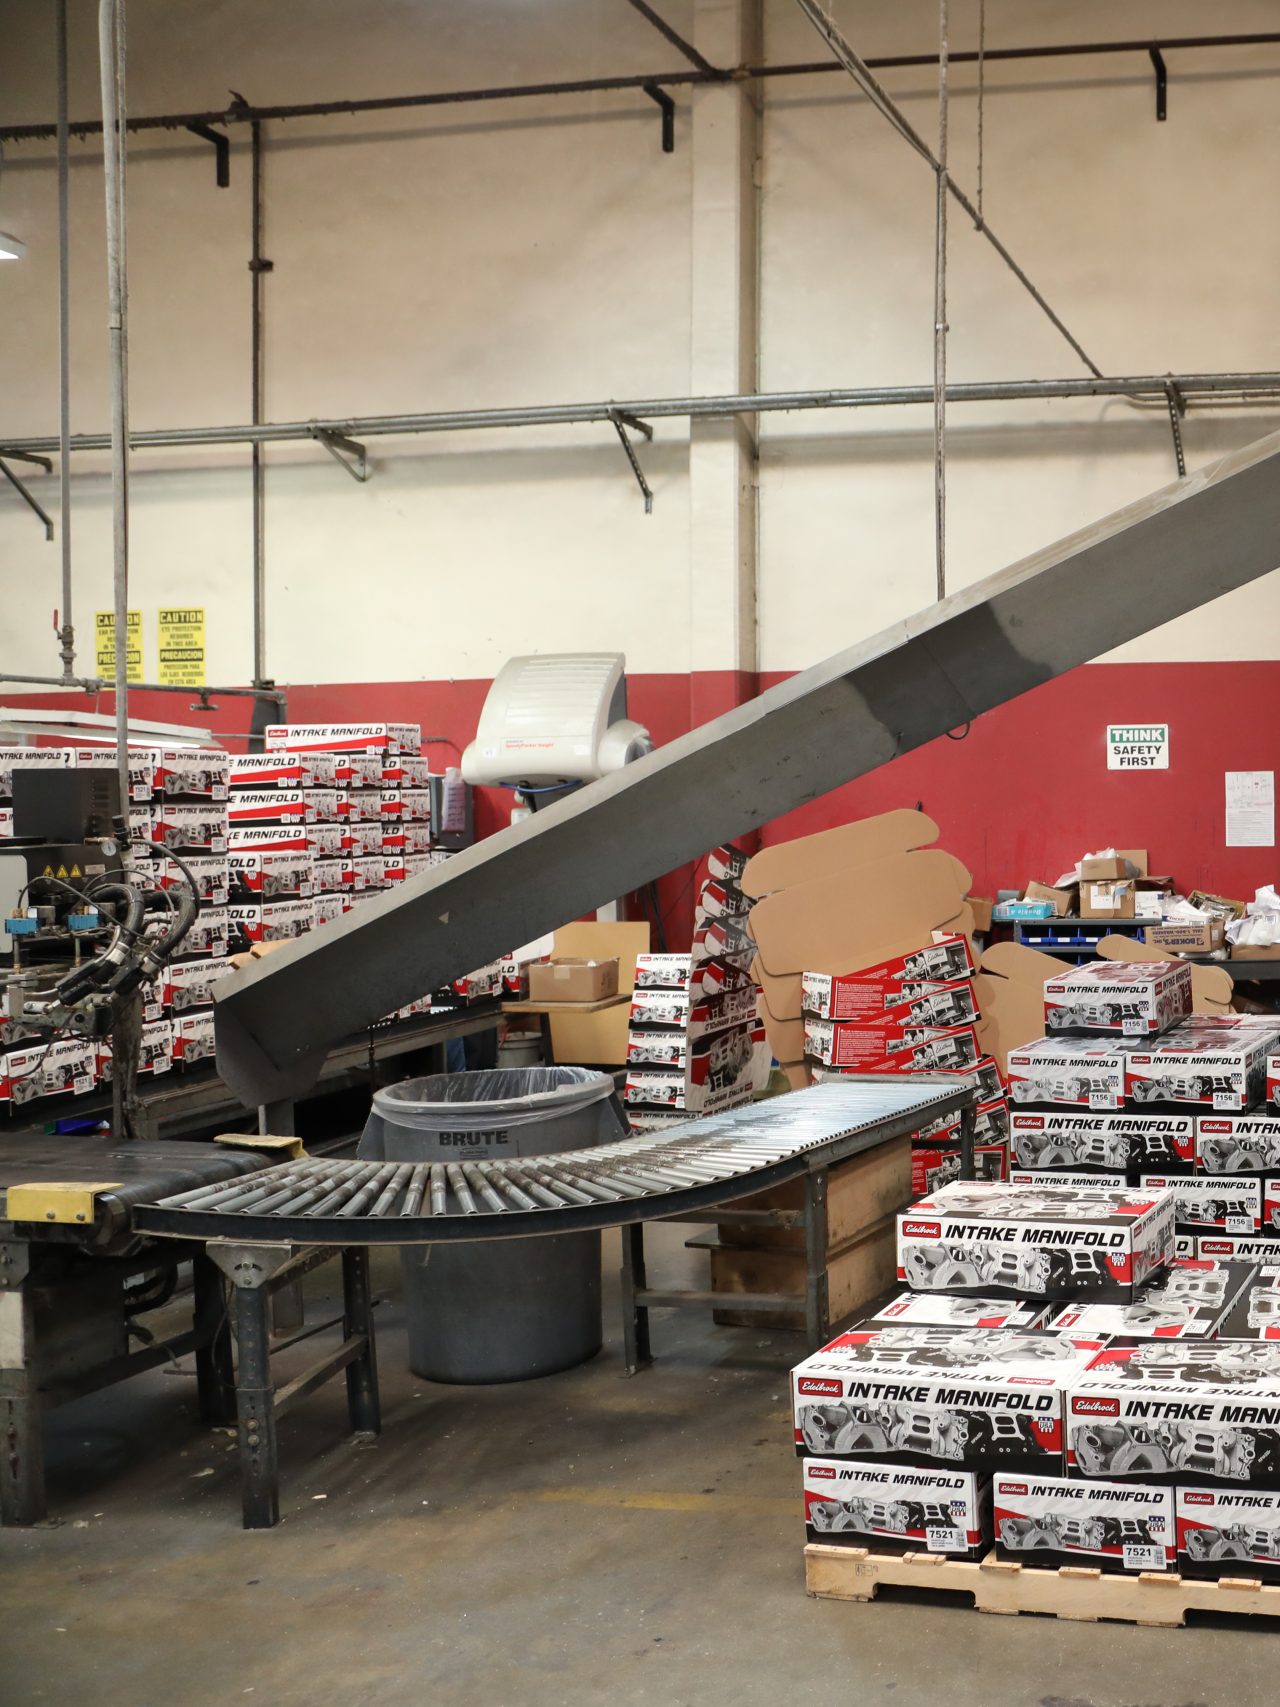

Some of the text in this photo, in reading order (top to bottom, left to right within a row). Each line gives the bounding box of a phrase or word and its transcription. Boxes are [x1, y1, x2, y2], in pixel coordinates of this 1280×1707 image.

[98, 615, 139, 626] CAUON
[161, 613, 202, 623] CAUTION
[291, 729, 328, 737] INTAKE
[330, 727, 383, 735] MANIFOLD
[1112, 729, 1163, 741] THINK
[1114, 746, 1162, 754] SAFETY
[25, 752, 61, 760] MANIFOLD
[237, 758, 296, 767] MANIFOLD
[1120, 757, 1156, 766] FIRST
[240, 794, 299, 803] MANIFOLD
[199, 807, 225, 815] MANIFOLD
[244, 830, 301, 839] MANIFOLD
[1102, 986, 1148, 994] MANIFOLD
[1032, 1058, 1118, 1068] INTAKE MANIFOLD
[1153, 1057, 1241, 1065] INTAKE MANIFOLD
[1048, 1118, 1104, 1130] INTAKE
[1108, 1120, 1188, 1132] MANIFOLD
[1202, 1123, 1230, 1131] Edelbrock
[440, 1131, 508, 1146] BRUTE
[1072, 1178, 1120, 1186] MANIFOLD
[1168, 1180, 1256, 1189] INTAKE MANIFOLD
[906, 1224, 1125, 1247] Edelbrock INTAKE MANIFOLD
[1204, 1244, 1231, 1252] Edelbrock
[929, 1371, 1004, 1382] INTAKE
[802, 1381, 1054, 1411] Edelbrock INTAKE MANIFOLD
[1074, 1400, 1116, 1412] Edelbrock
[1125, 1401, 1213, 1420] INTAKE
[810, 1469, 964, 1488] Edelbrock INTAKE MANIFOLD
[1000, 1485, 1164, 1503] Edelbrock INTAKE MANIFOLD
[1186, 1494, 1212, 1503] Edelbrock
[1217, 1496, 1272, 1508] INTAKE
[929, 1530, 953, 1539] 7521
[1126, 1547, 1152, 1556] 7521
